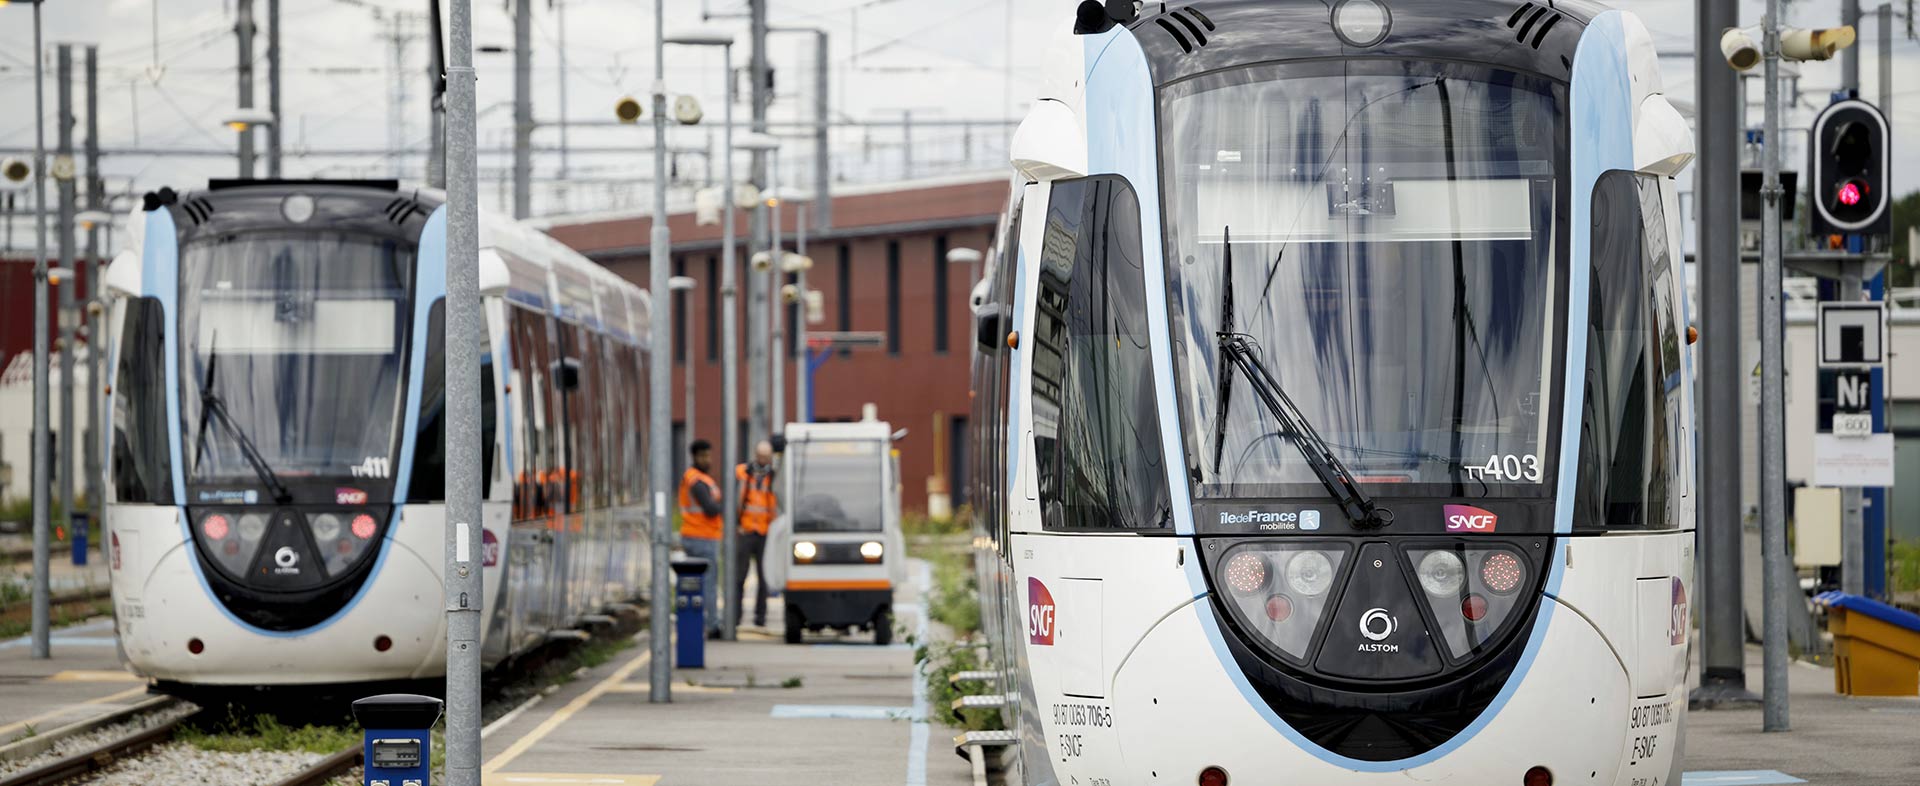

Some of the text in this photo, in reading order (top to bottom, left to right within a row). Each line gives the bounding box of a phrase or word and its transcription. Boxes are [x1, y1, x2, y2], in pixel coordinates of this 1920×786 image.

[1837, 376, 1868, 408] Nf
[1260, 521, 1295, 530] mobilités
[1448, 515, 1493, 529] SNCF
[1030, 604, 1053, 637] SNCF
[1358, 644, 1398, 652] ALSTOM
[1087, 705, 1112, 728] 706-5
[1631, 706, 1642, 728] 90
[1642, 706, 1650, 727] 87
[1060, 734, 1082, 758] F-SNCF
[1631, 735, 1657, 760] F-SNCF
